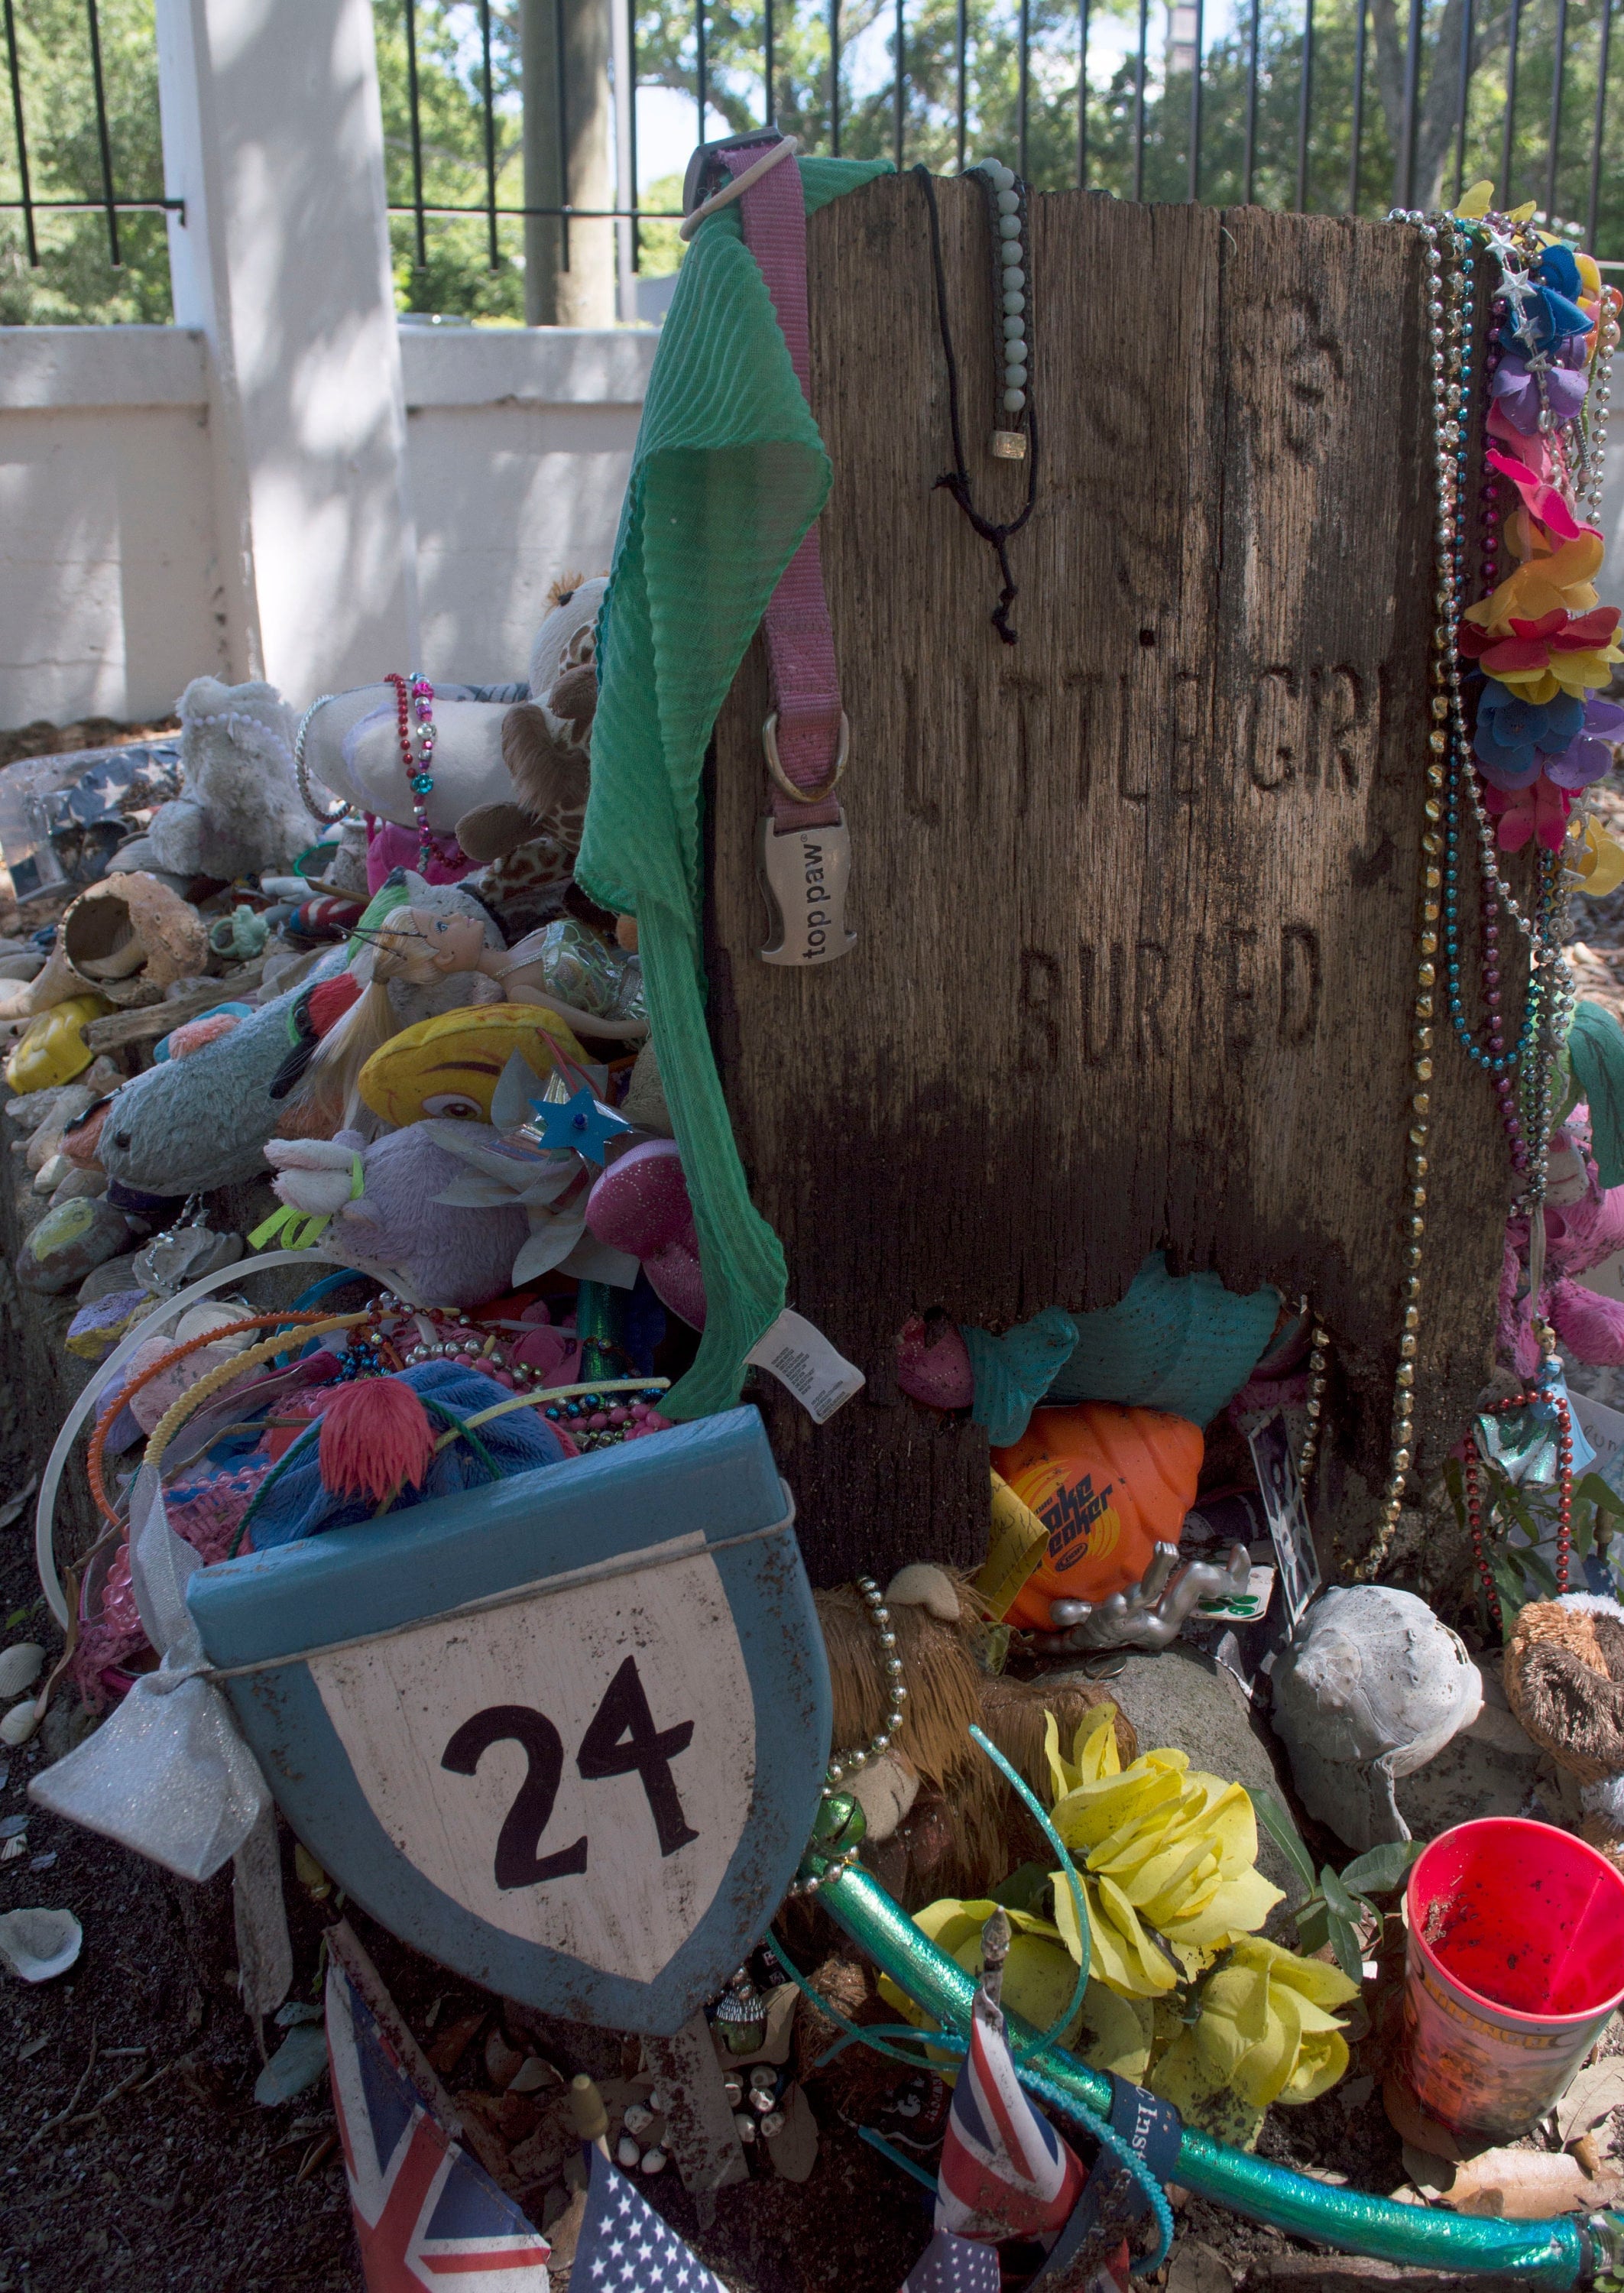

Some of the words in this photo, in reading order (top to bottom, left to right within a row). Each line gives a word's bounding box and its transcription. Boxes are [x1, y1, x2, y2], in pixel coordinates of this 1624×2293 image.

[903, 666, 1201, 824] LITTLE
[803, 843, 831, 903] paw
[803, 910, 831, 959] top
[1019, 923, 1320, 1070] BURIED
[441, 1655, 699, 1890] 24
